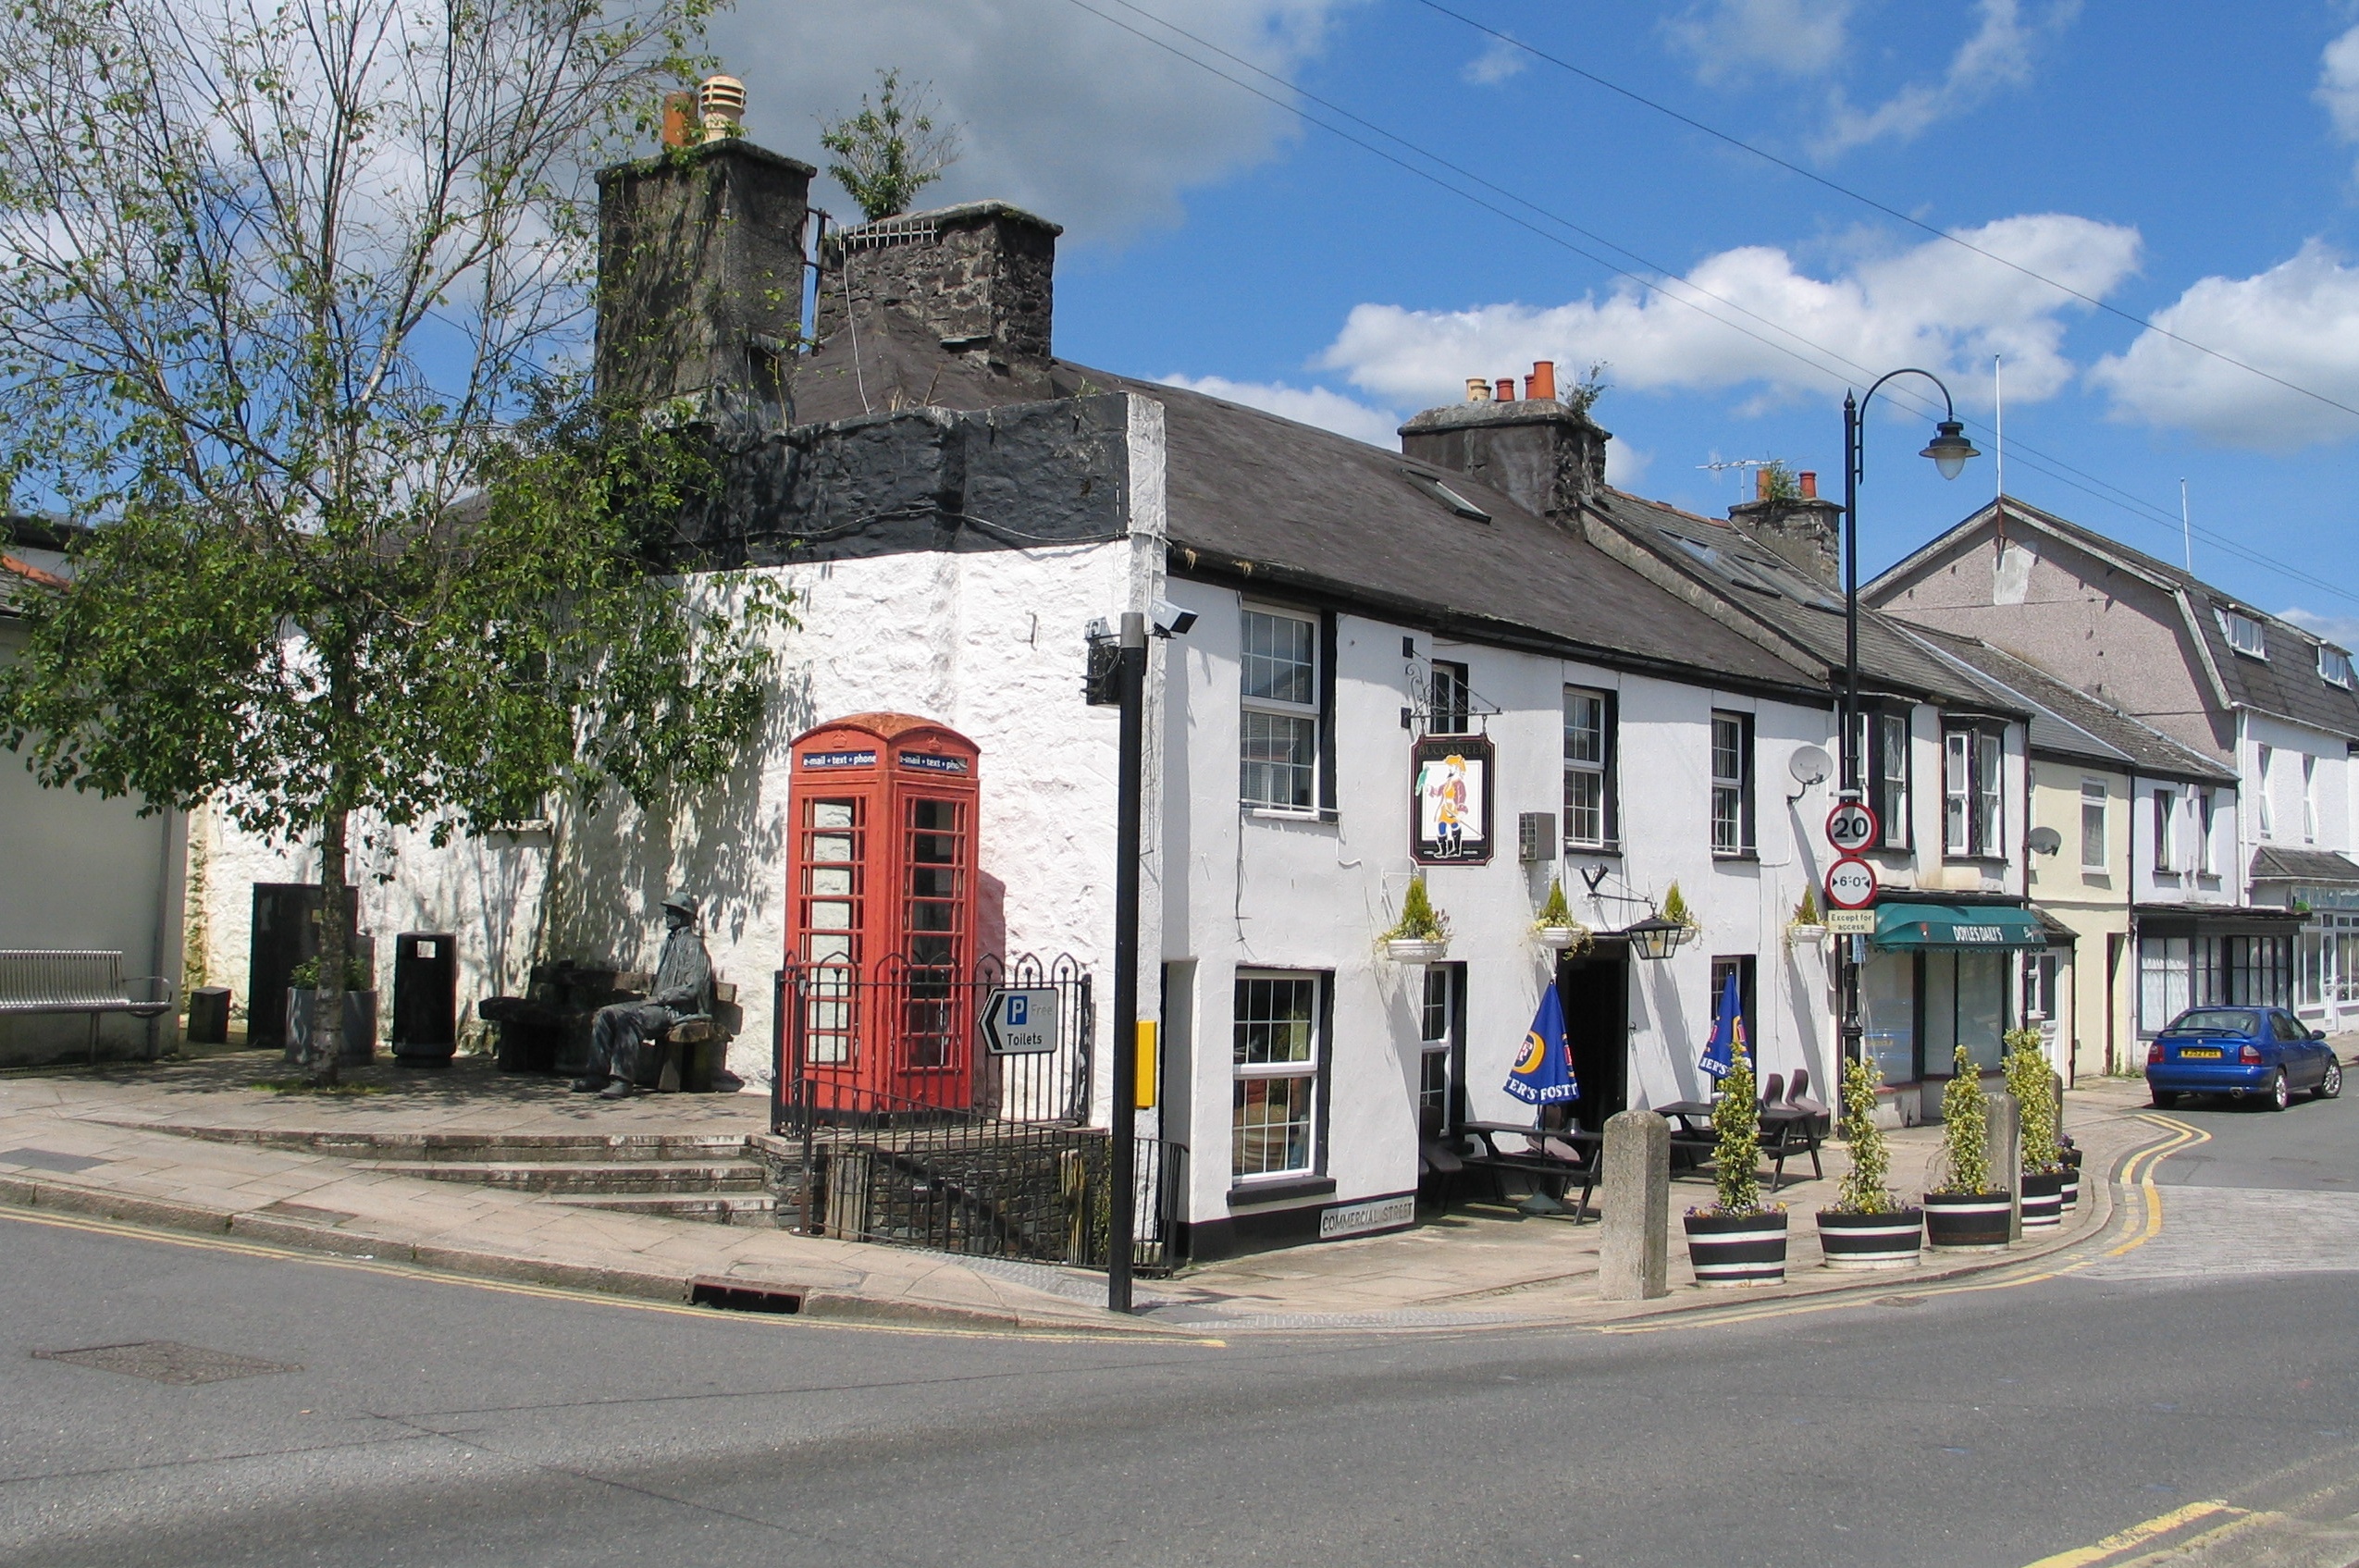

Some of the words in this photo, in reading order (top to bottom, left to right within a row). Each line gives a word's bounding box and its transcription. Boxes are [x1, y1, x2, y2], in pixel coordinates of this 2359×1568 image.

[1418, 745, 1488, 756] BUCCANEER
[803, 755, 826, 766] e-mail
[832, 755, 847, 765] text
[853, 753, 877, 766] phone
[926, 758, 941, 768] text
[1834, 817, 1869, 838] 20
[1831, 913, 1859, 922] Except
[1952, 925, 1981, 942] DOYLES
[1012, 999, 1025, 1023] P
[1031, 1004, 1053, 1016] Free
[1007, 1032, 1043, 1045] Toilets
[1322, 1210, 1377, 1231] COMMERCIAL
[1383, 1202, 1413, 1221] STREET
